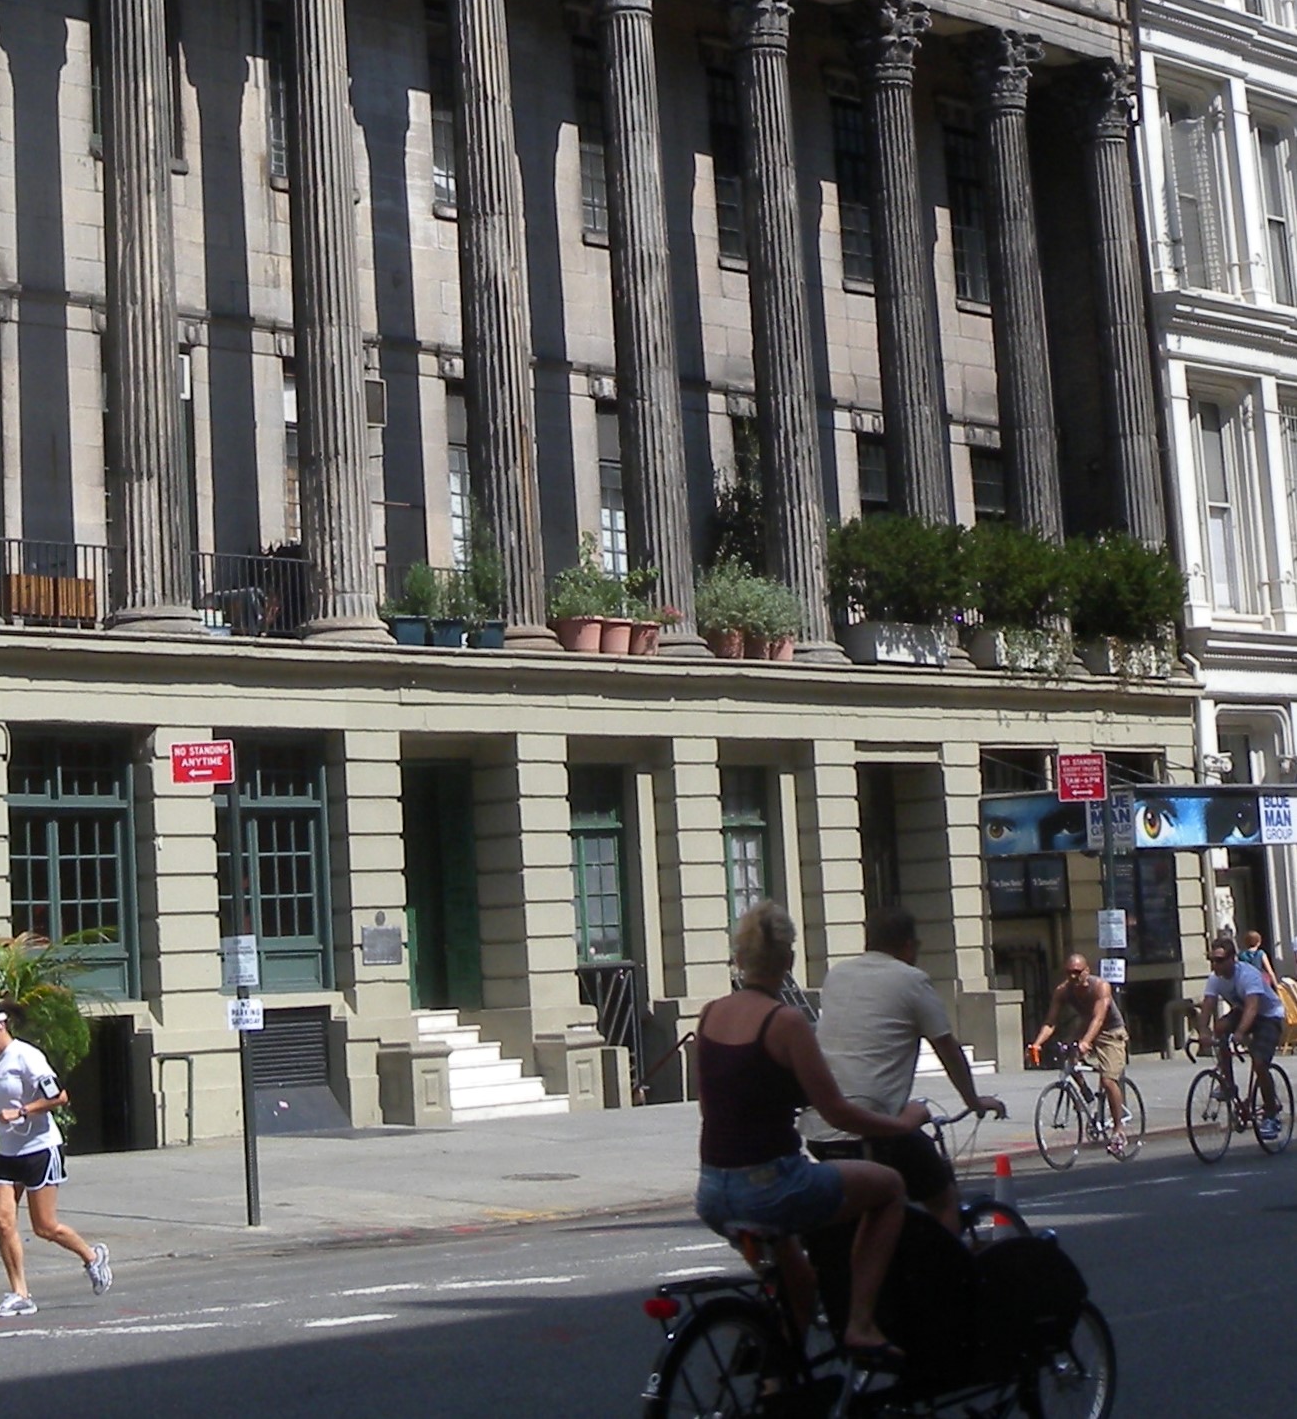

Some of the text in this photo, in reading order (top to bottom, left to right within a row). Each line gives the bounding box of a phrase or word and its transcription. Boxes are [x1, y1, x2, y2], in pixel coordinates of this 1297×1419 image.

[174, 745, 229, 756] NO STANDING
[181, 757, 223, 767] ANYTIME
[1061, 757, 1102, 766] NO STANDING
[1091, 794, 1130, 809] BUE
[1264, 796, 1290, 808] BLUE
[1264, 810, 1292, 827] MAN
[1266, 828, 1293, 840] GROUP
[240, 1000, 251, 1008] NO
[231, 1008, 261, 1017] PARKING
[231, 1017, 261, 1026] SATURDAY
